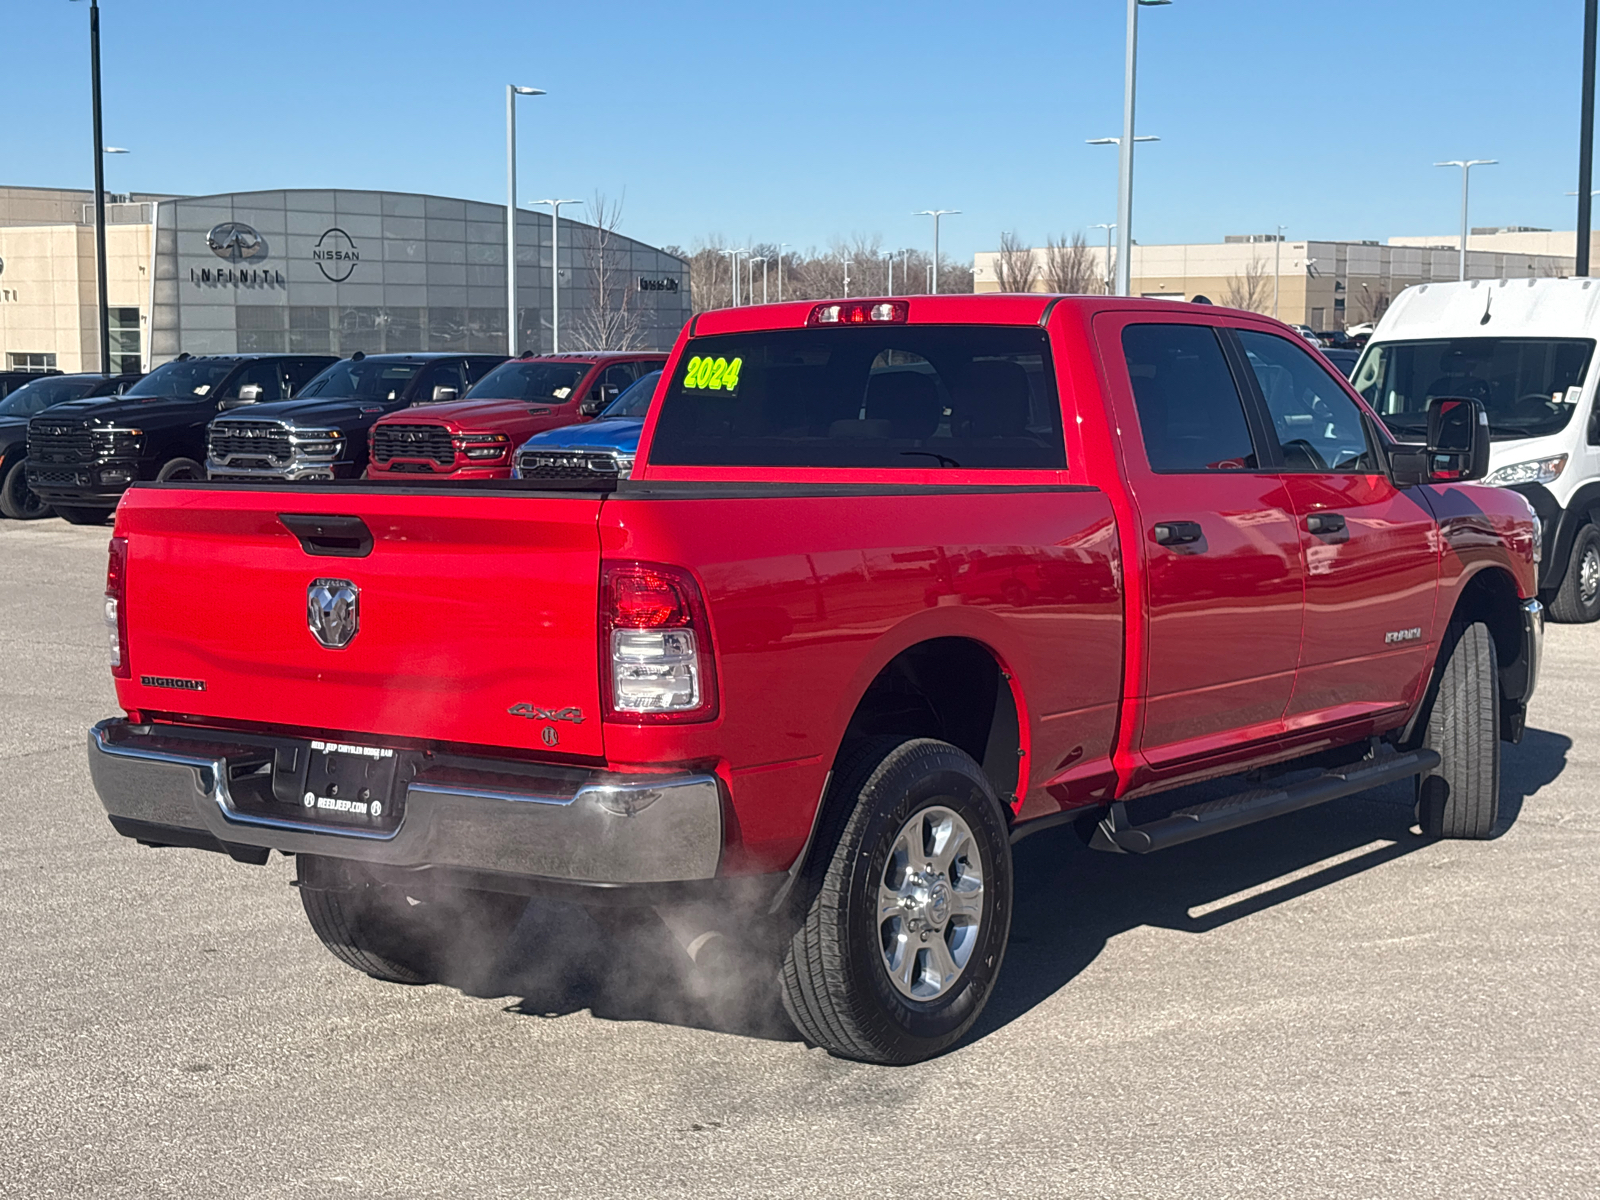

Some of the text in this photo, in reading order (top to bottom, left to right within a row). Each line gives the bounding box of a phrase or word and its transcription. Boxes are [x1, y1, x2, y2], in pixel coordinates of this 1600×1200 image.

[313, 250, 359, 261] NISSAN
[190, 268, 279, 283] INFINITI
[0, 289, 18, 303] TI
[683, 356, 742, 391] 2024
[226, 428, 266, 438] RAM
[539, 457, 586, 468] RAM
[1384, 627, 1421, 643] RAM
